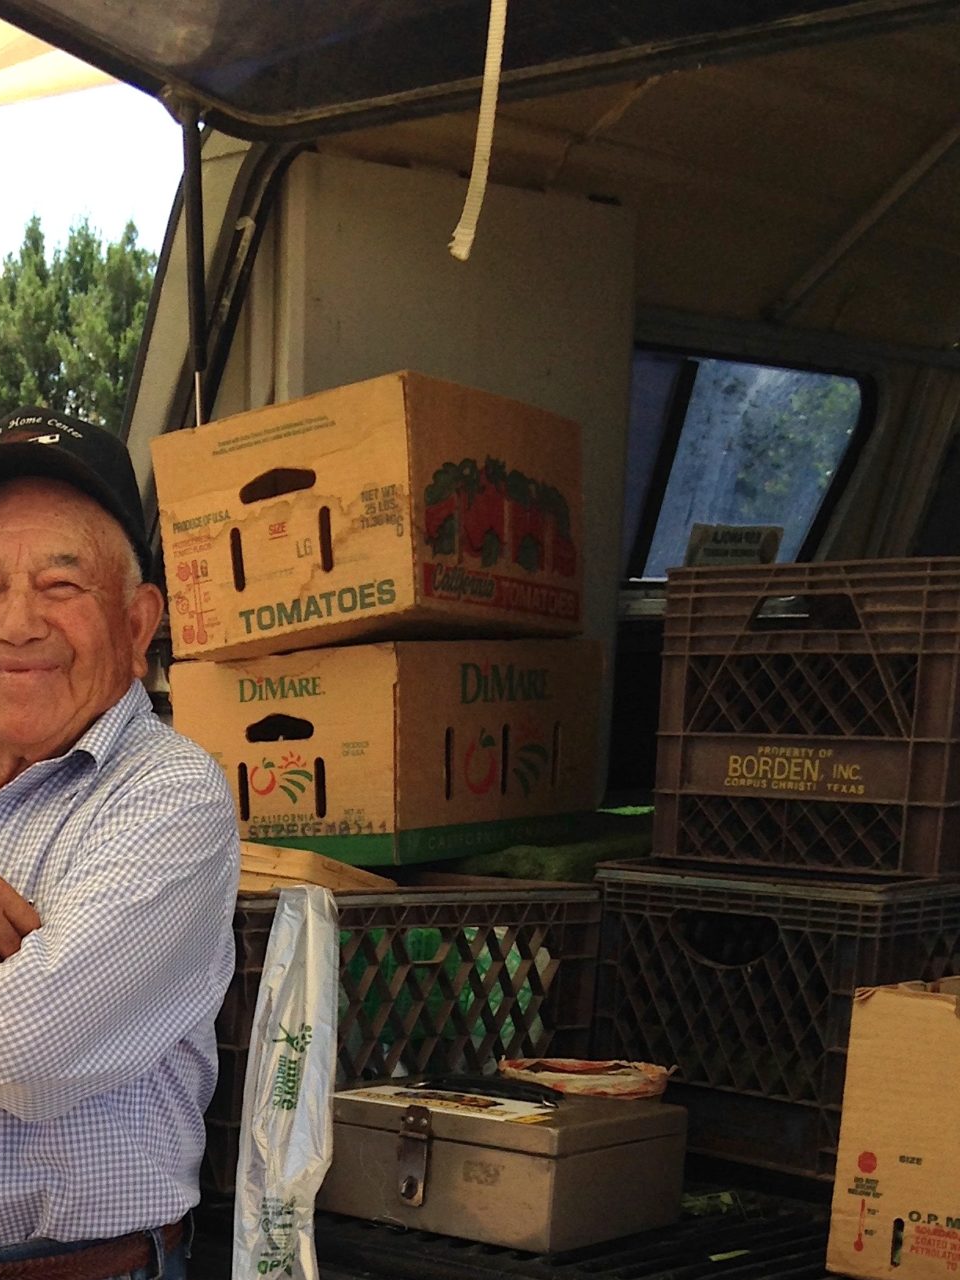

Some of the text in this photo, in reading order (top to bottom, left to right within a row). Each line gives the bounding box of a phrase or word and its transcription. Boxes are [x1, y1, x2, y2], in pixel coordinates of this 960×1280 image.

[8, 416, 43, 429] Home
[47, 418, 83, 439] Center
[361, 488, 379, 502] NET
[365, 504, 377, 515] 25
[269, 521, 287, 536] SIZE
[296, 537, 313, 558] LG
[238, 579, 397, 634] TOMATOES
[239, 676, 321, 703] DiMARE
[757, 746, 833, 758] PROPERTY OF
[832, 763, 863, 781] INC.
[724, 778, 767, 789] CORPUS
[826, 782, 865, 795] TEXAS
[252, 812, 315, 824] CALIFORNIA
[282, 1059, 297, 1110] more
[899, 1155, 922, 1165] SIZE
[908, 1210, 940, 1226] O.P.
[915, 1238, 947, 1249] COATED
